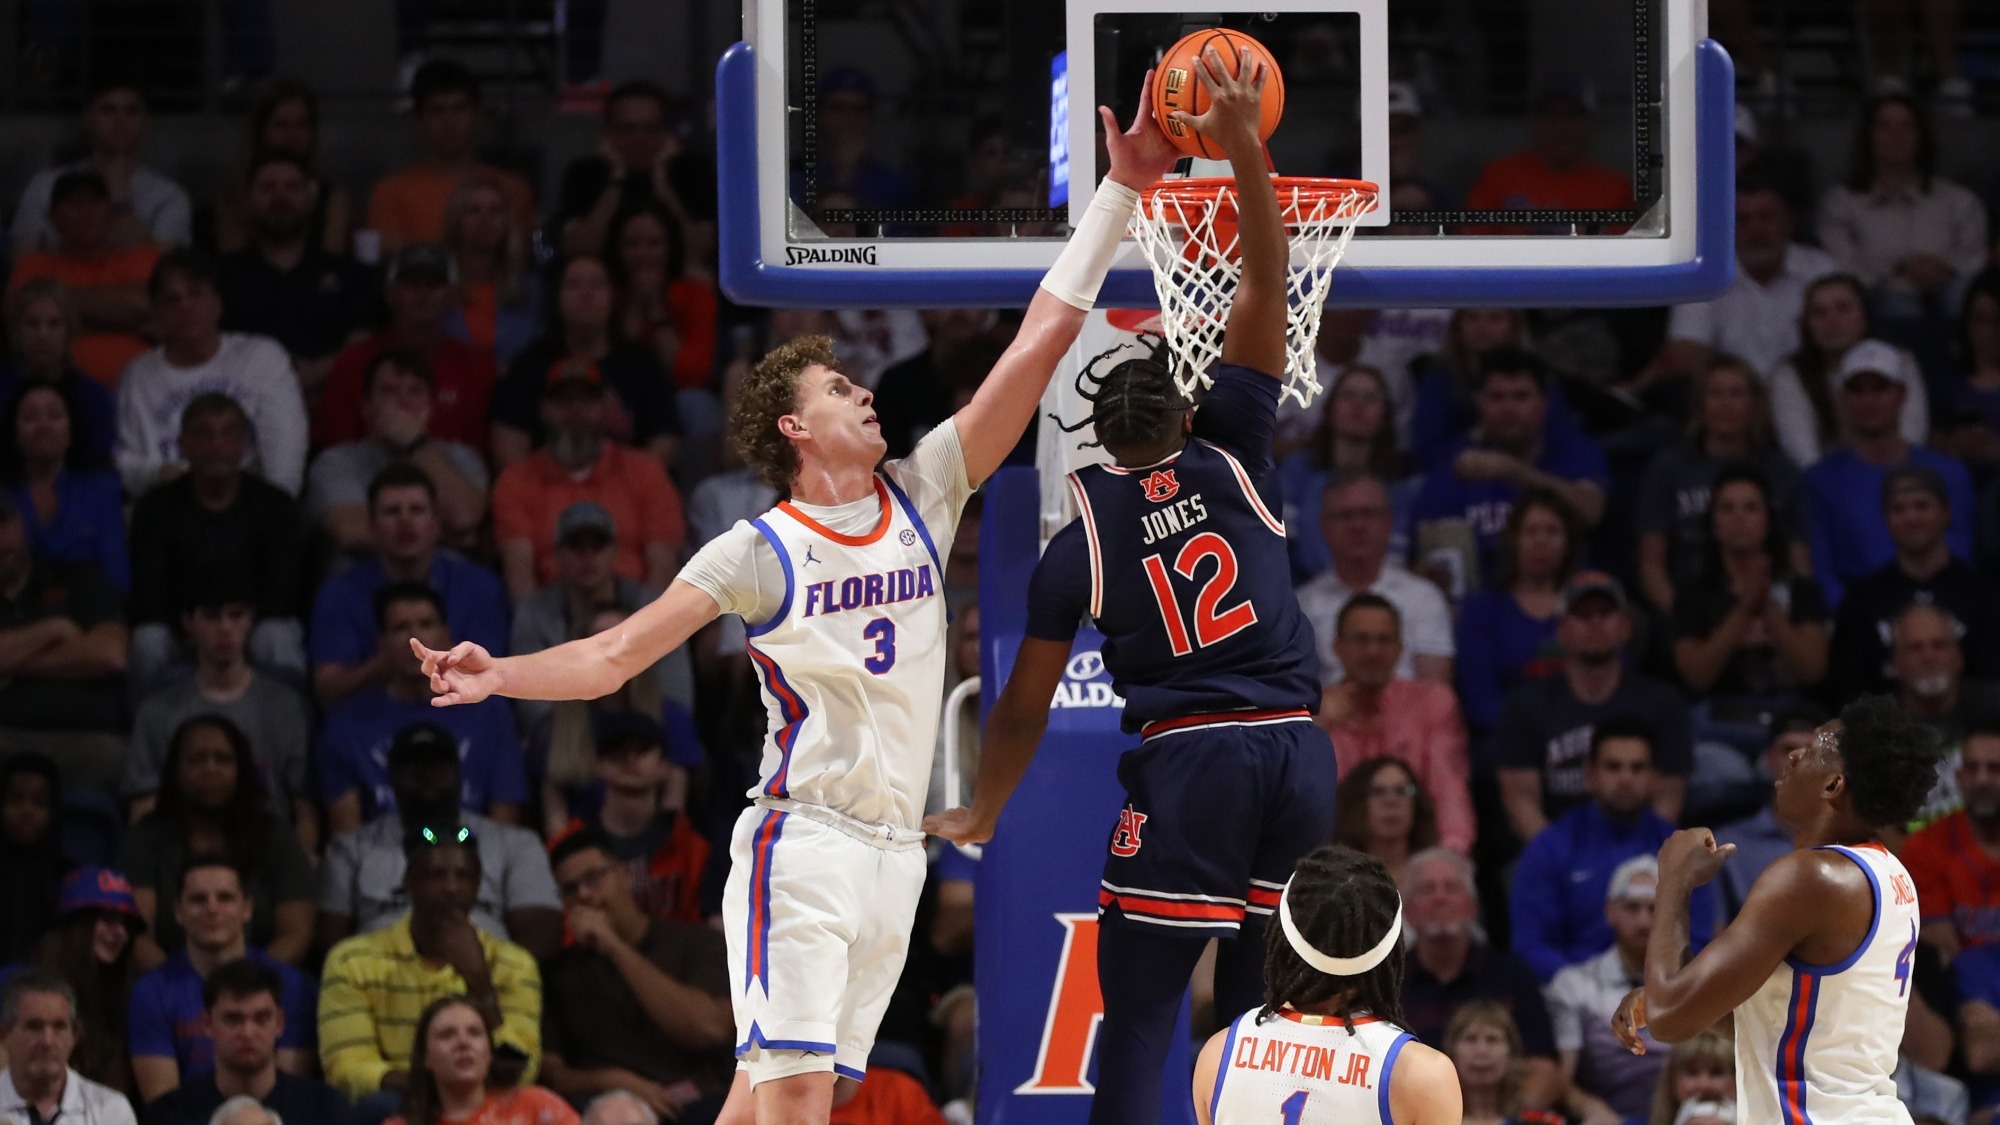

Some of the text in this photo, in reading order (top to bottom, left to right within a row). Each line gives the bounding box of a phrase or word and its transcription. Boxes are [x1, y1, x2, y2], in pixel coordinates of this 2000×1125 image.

[785, 245, 877, 266] SPALDING
[1140, 493, 1208, 545] JONES
[802, 564, 934, 618] FLORIDA
[1141, 531, 1258, 657] 12
[863, 617, 895, 675] 3
[1894, 917, 1917, 998] 4
[1235, 1036, 1372, 1089] CLAYTON JR.
